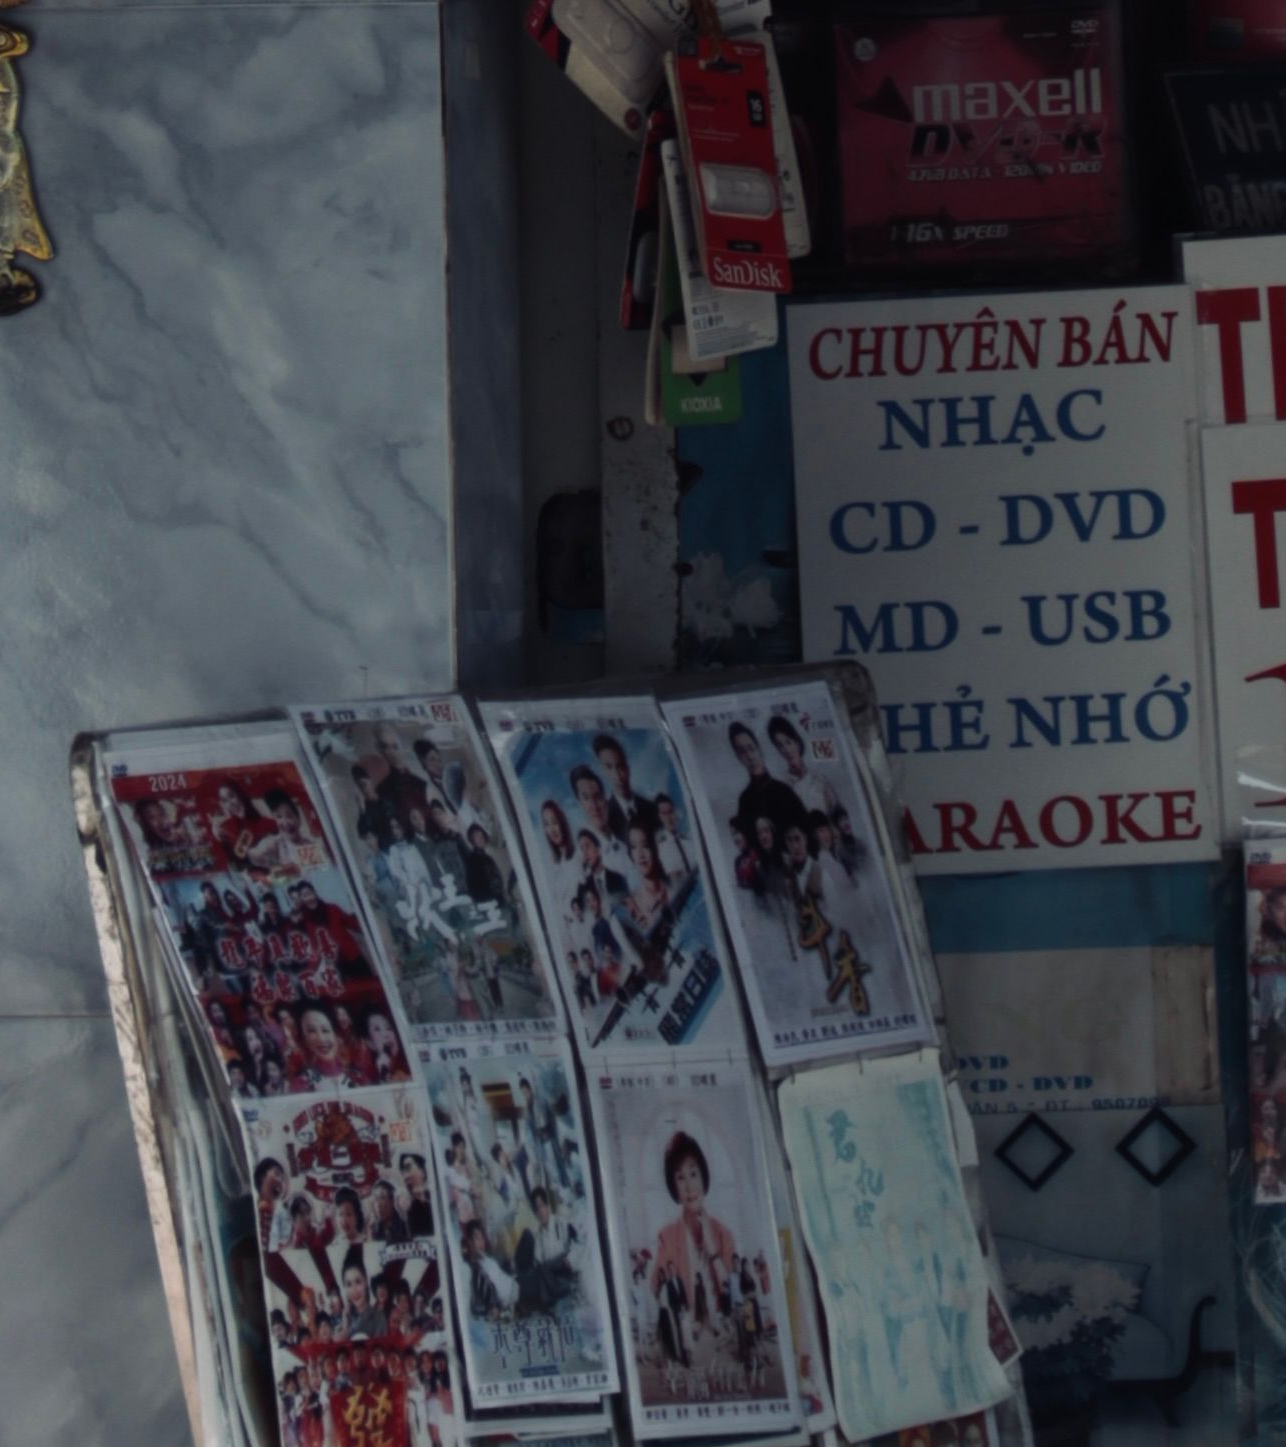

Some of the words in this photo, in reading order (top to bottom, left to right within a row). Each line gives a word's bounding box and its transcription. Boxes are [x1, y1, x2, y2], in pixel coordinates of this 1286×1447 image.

[912, 67, 1103, 123] maxell
[1057, 160, 1104, 176] VIDEO
[953, 222, 1010, 242] SPEED
[713, 260, 783, 290] SanDisk
[806, 306, 1053, 382] CHUYÊN
[1057, 296, 1180, 367] BÁN
[878, 387, 1106, 458] NHẠC
[829, 497, 939, 557] CD
[999, 487, 1167, 547] DVD
[833, 597, 960, 656] MD
[1026, 588, 1173, 649] USB
[879, 685, 991, 755] HẺ
[1007, 674, 1194, 749] NHỚ
[148, 775, 187, 792] 2024
